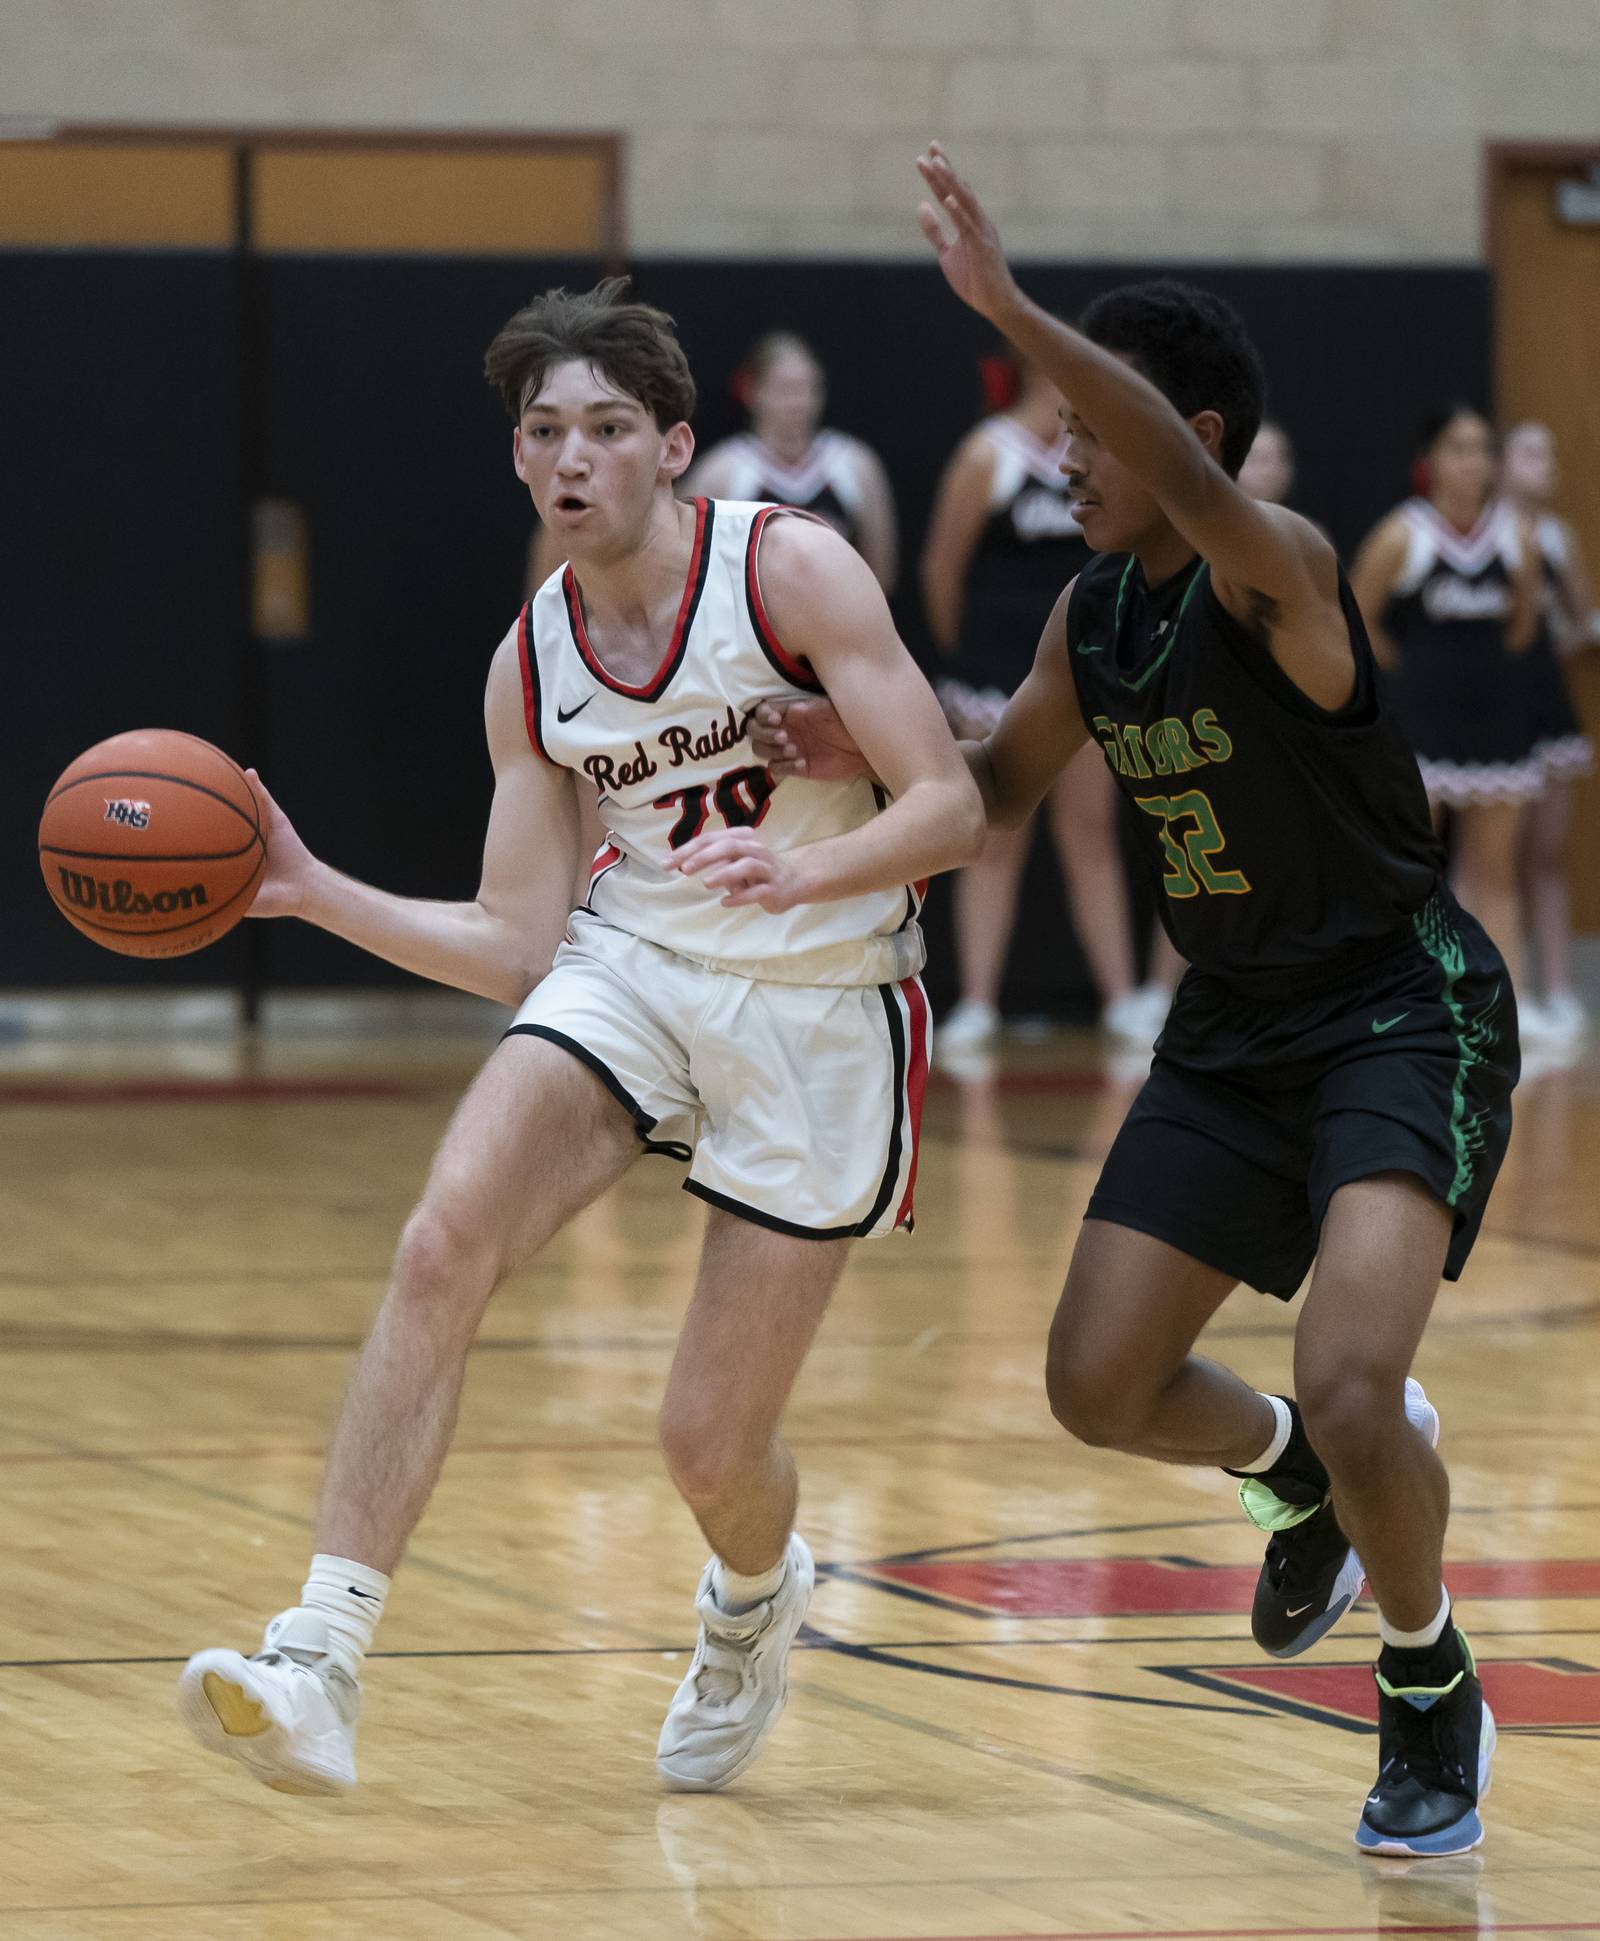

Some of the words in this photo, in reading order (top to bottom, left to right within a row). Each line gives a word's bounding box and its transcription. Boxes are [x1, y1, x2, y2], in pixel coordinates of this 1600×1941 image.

[583, 741, 657, 792] Red
[658, 699, 760, 767] Raid
[105, 800, 150, 829] HHS
[58, 865, 208, 915] Wilson
